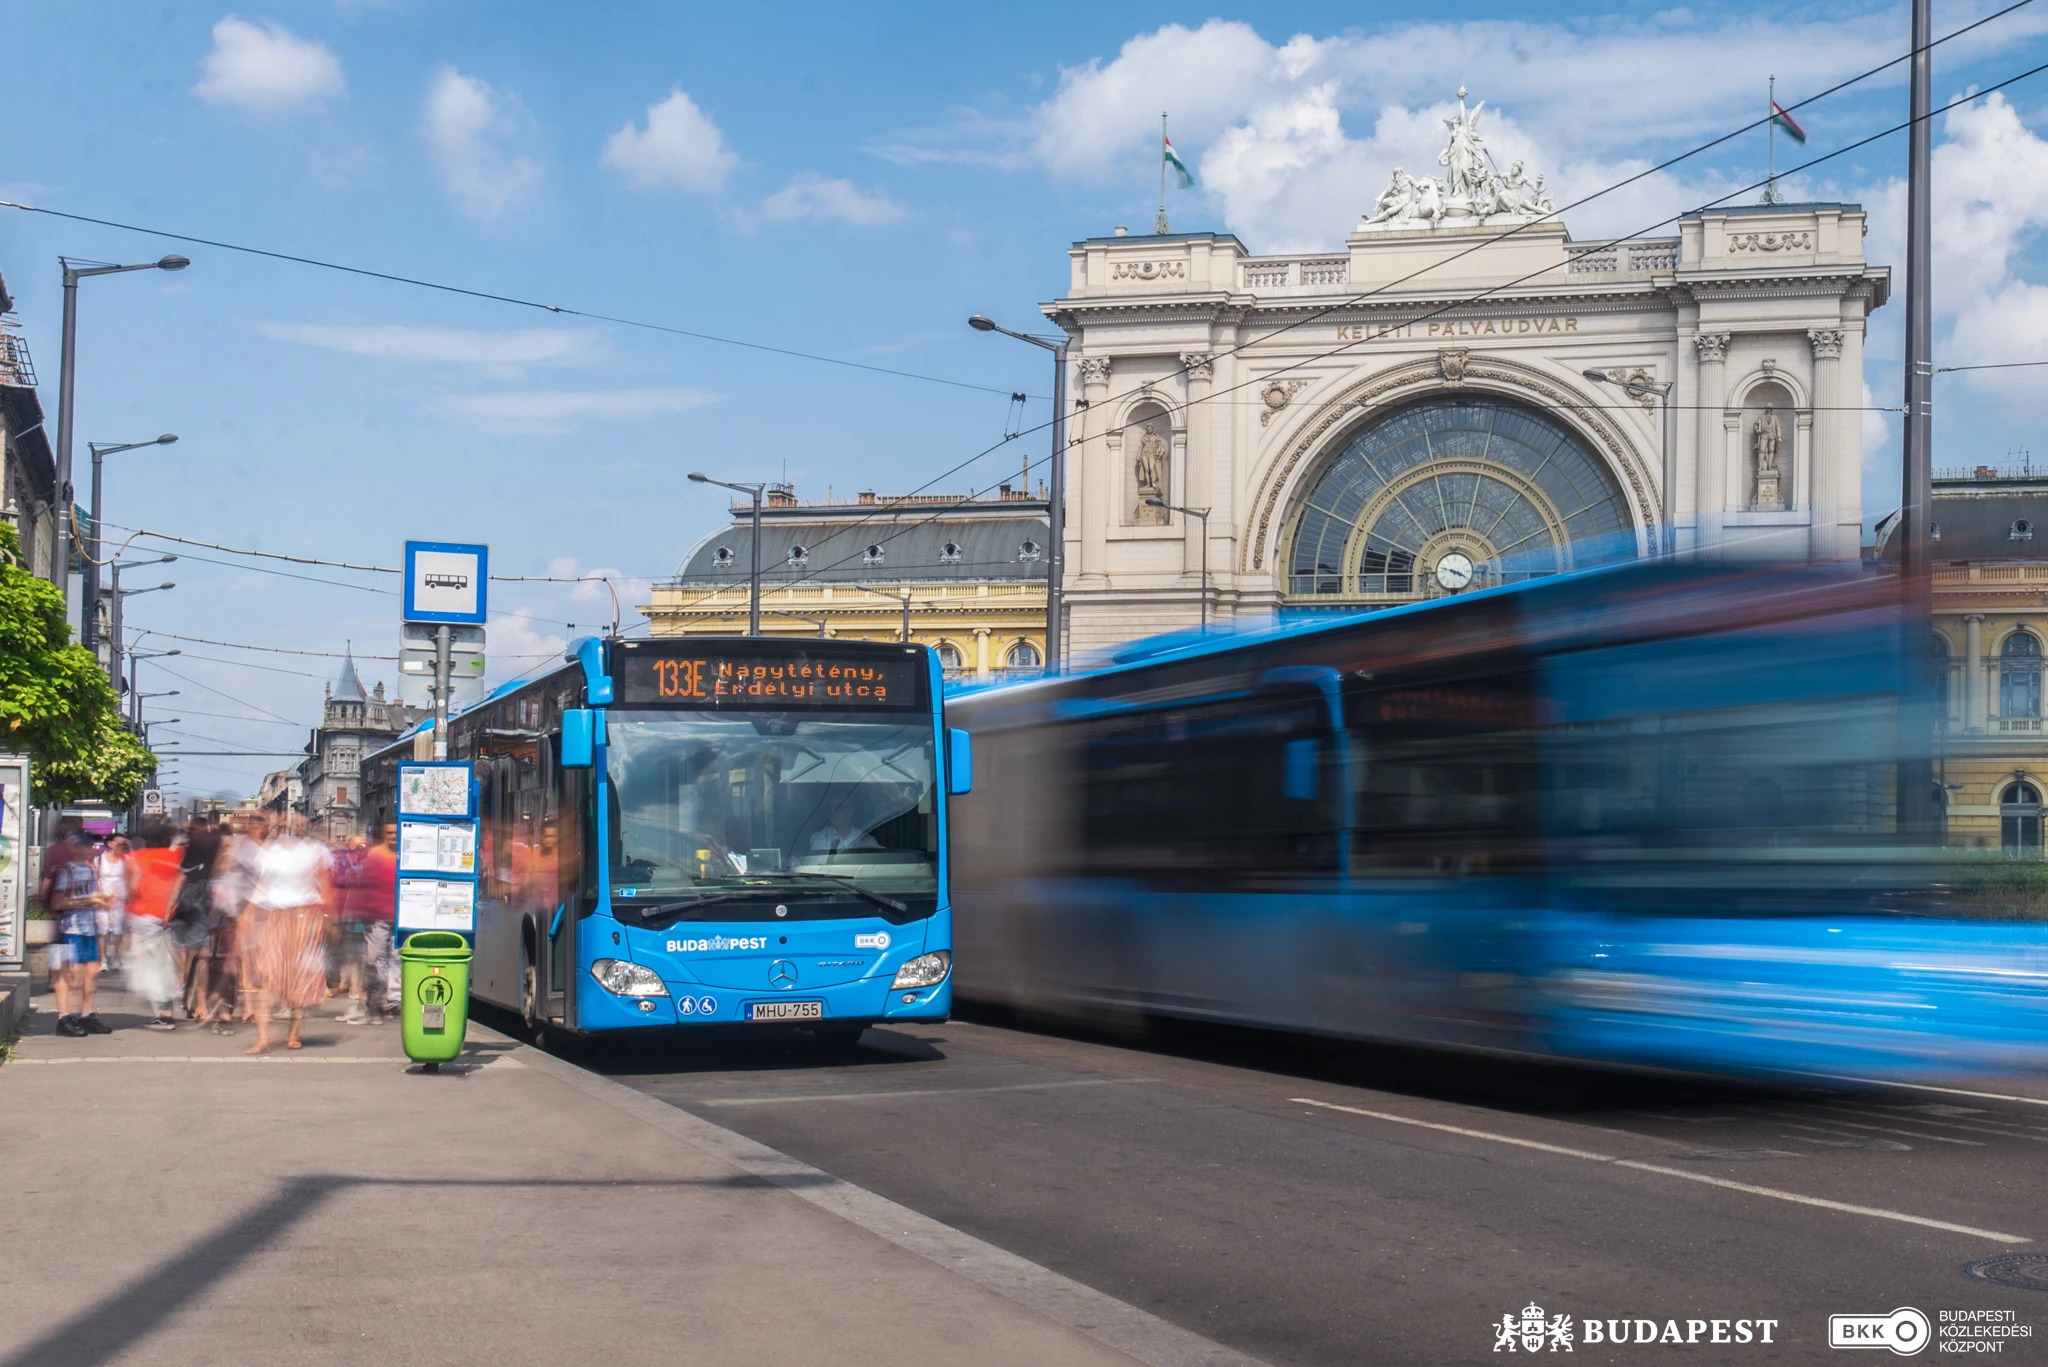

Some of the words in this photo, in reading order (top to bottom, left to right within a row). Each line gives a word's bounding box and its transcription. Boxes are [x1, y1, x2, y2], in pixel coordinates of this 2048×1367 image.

[1337, 324, 1412, 340] KELETI
[1428, 317, 1578, 336] PÁLYAUDVAR
[653, 660, 706, 697] 133E
[719, 662, 884, 681] Nagytétény,
[715, 681, 814, 697] Erdélyi
[827, 681, 887, 697] utca
[756, 1003, 819, 1018] MHU-755
